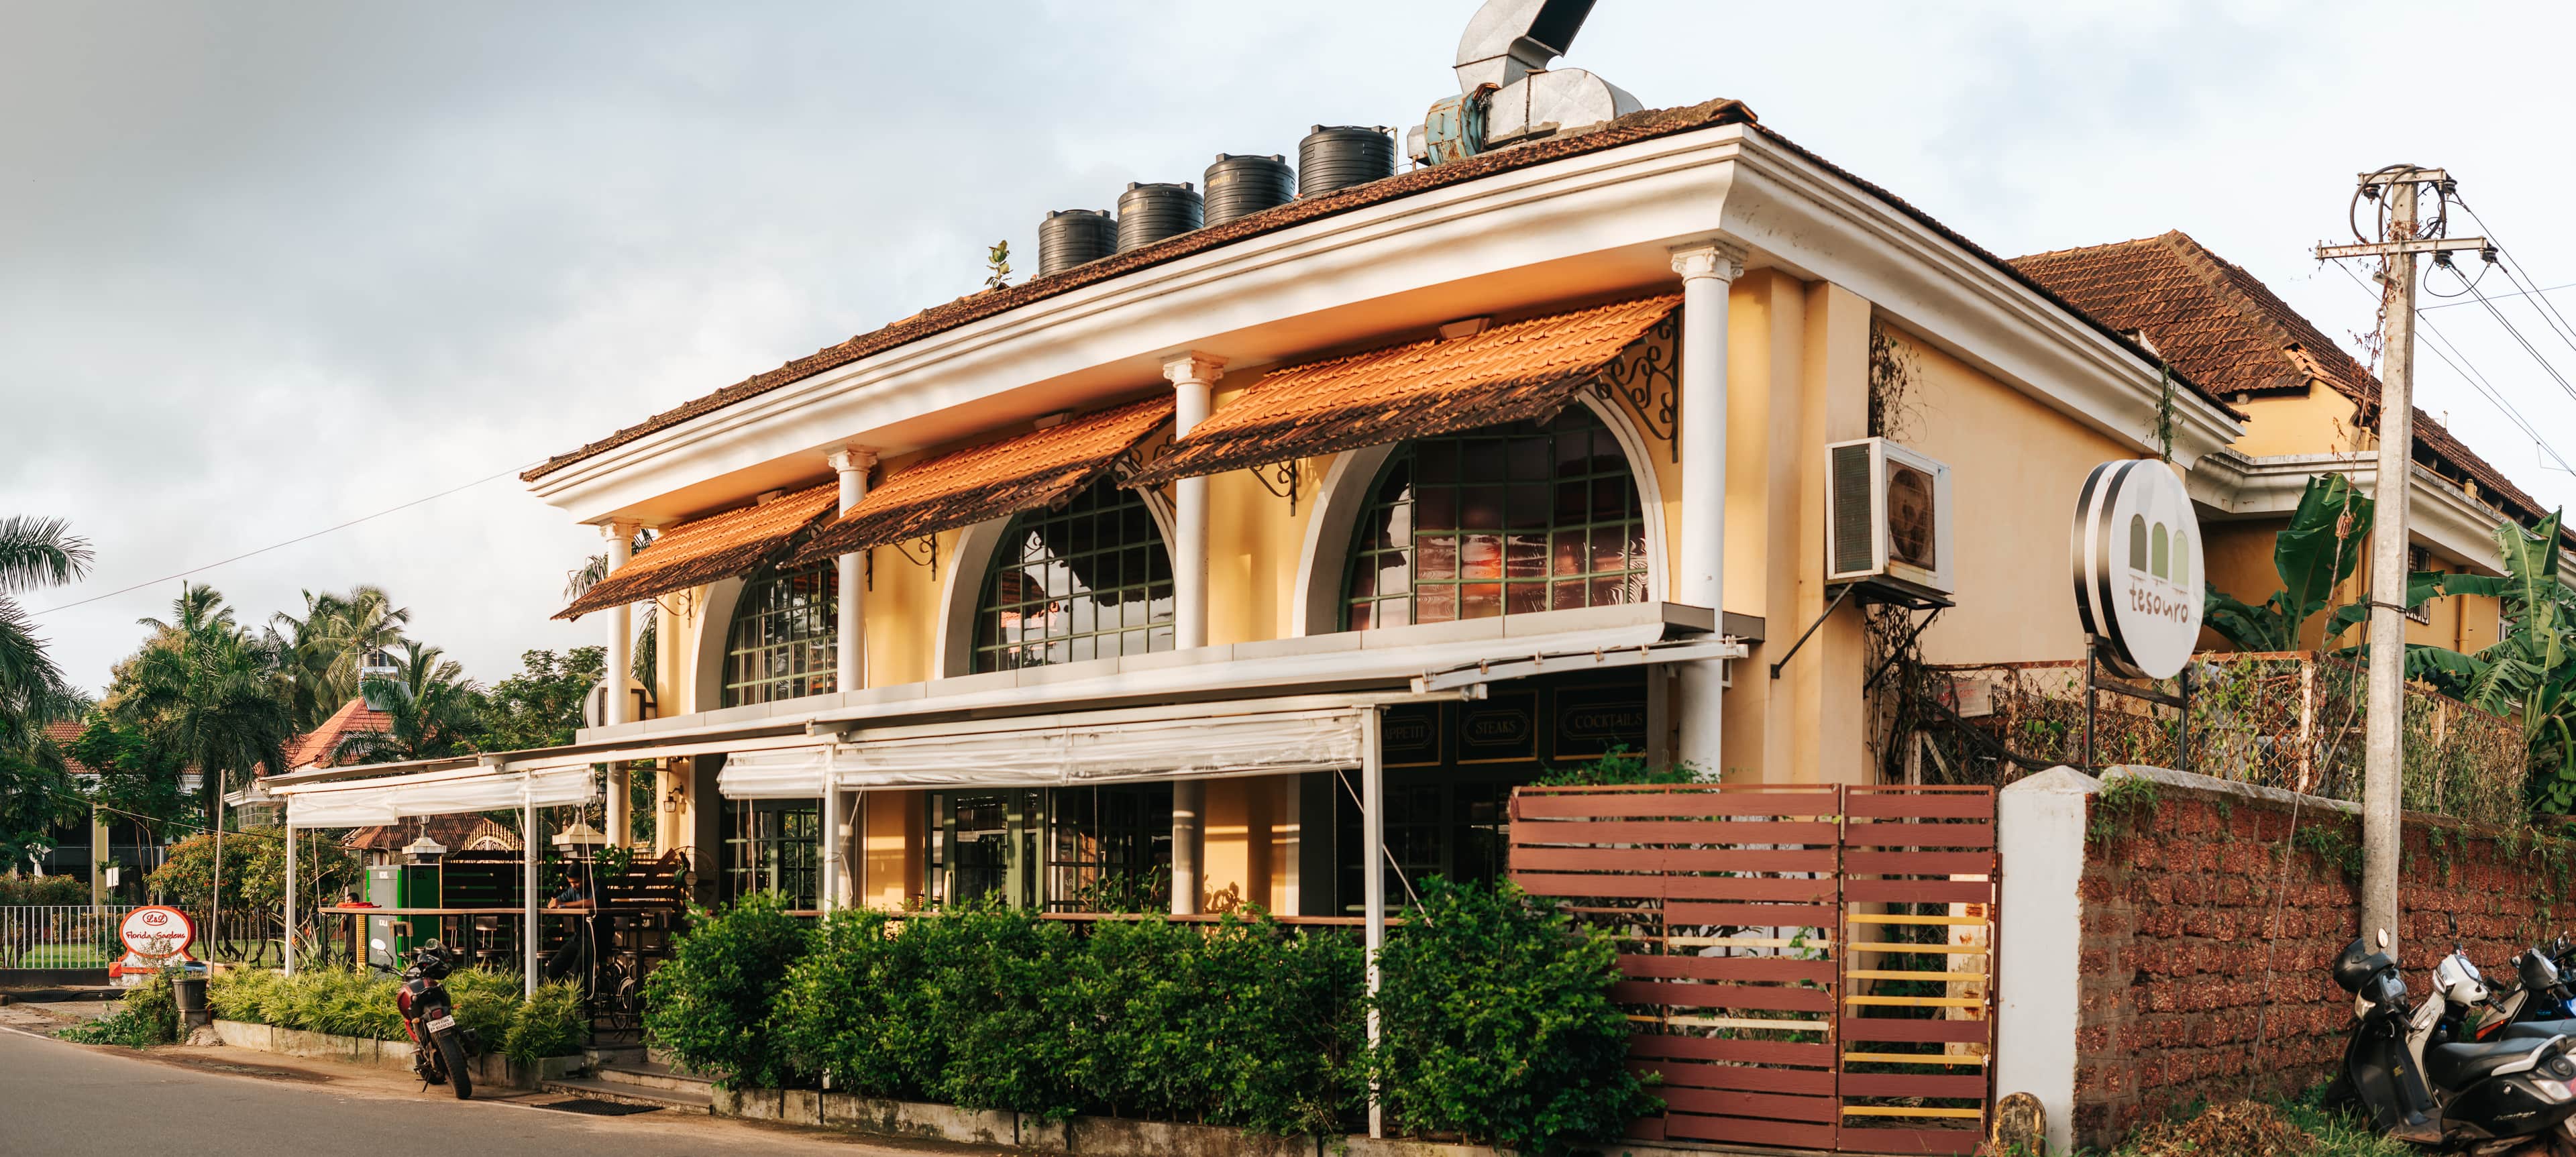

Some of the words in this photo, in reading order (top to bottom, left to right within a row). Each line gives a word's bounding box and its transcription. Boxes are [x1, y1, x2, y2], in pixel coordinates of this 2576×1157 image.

[2129, 579, 2188, 622] tesouro
[1475, 720, 1515, 734] STEAKS
[1574, 712, 1643, 729] COCKTAILS
[147, 914, 165, 923] L&L
[125, 931, 151, 939] Florida
[156, 931, 185, 939] Gardens
